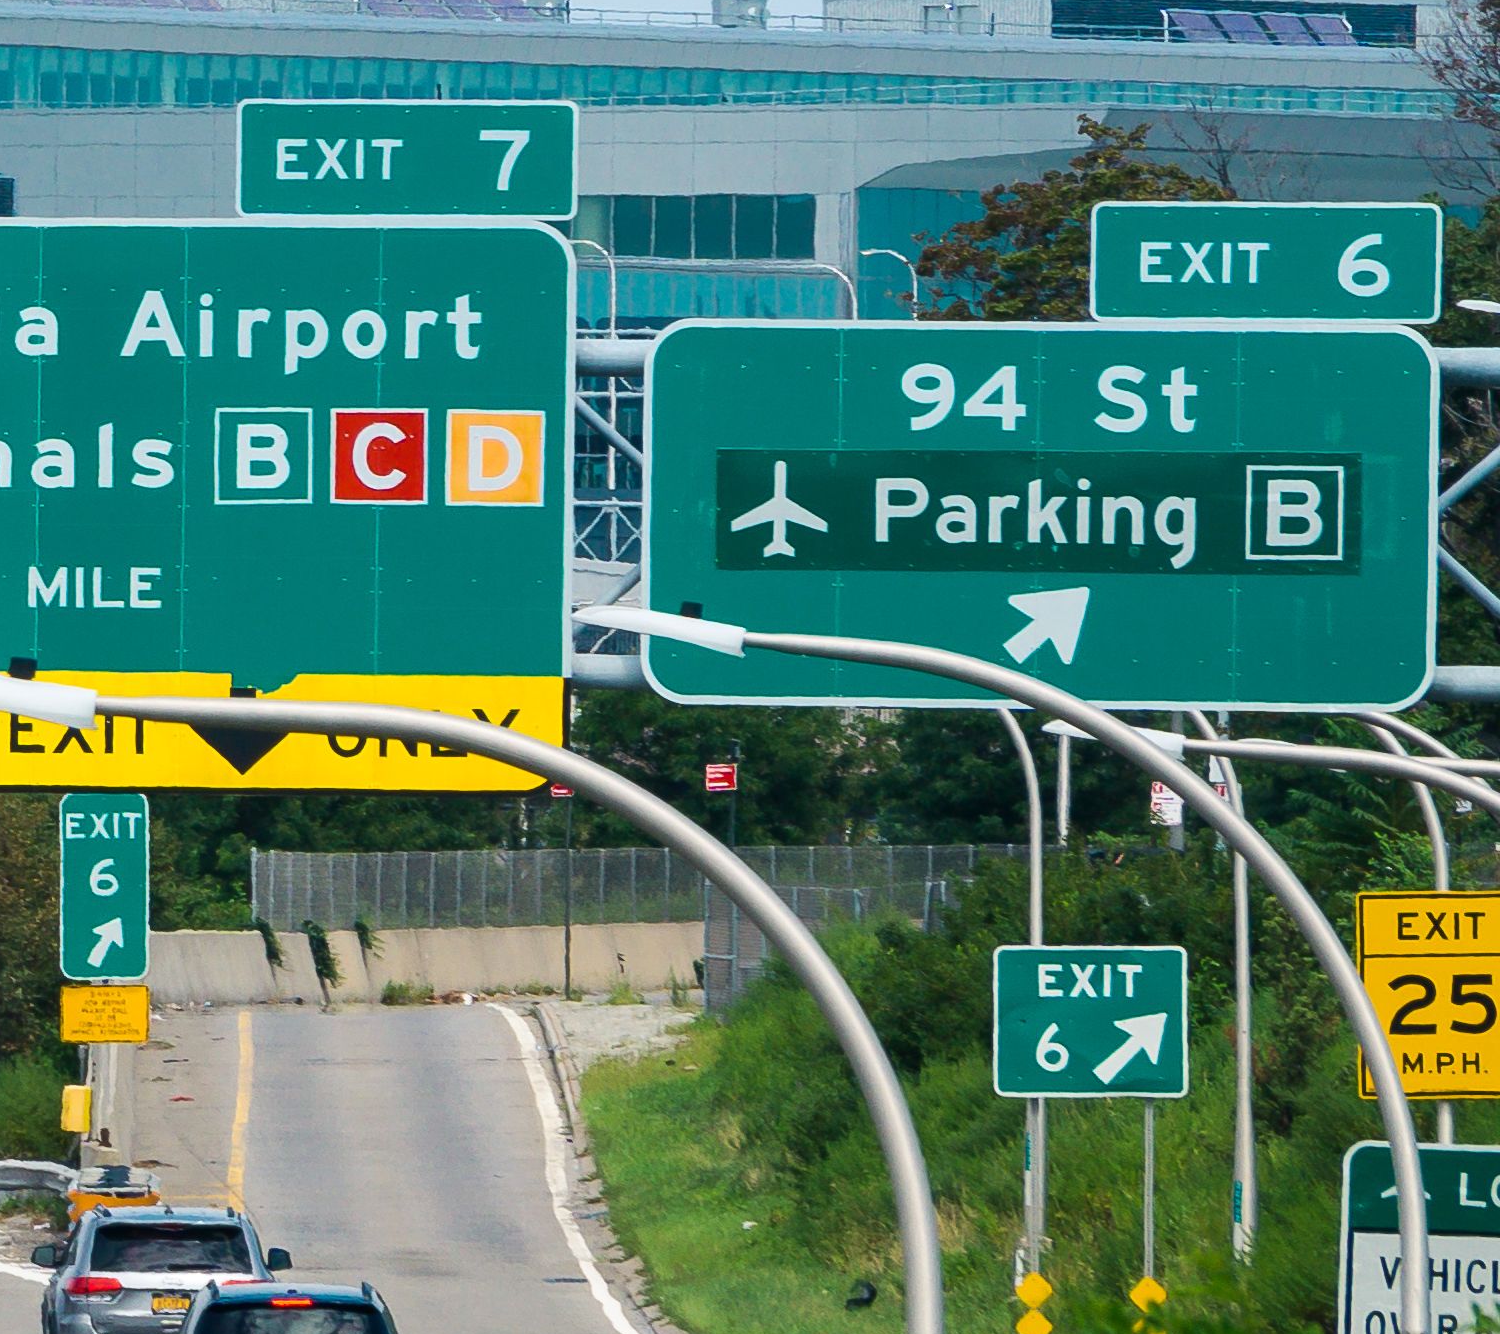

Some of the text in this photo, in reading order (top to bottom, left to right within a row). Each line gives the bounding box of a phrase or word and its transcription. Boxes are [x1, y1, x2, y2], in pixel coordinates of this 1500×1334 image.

[275, 130, 531, 192] EXIT 7
[1138, 233, 1391, 298] EXIT 6
[121, 291, 483, 373] Airport
[900, 363, 1199, 433] 94 St
[237, 424, 292, 489] B
[350, 424, 408, 490] C
[467, 425, 523, 490] D
[875, 478, 1322, 569] Parking B
[27, 566, 162, 609] MILE
[9, 710, 146, 755] EXIT
[65, 812, 141, 840] EXIT
[89, 858, 119, 896] 6
[1397, 912, 1486, 940] EXIT
[1037, 963, 1142, 998] EXIT
[1388, 973, 1498, 1035] 25
[1035, 1023, 1069, 1072] 6
[1402, 1052, 1489, 1075] M.P.H.
[1380, 1257, 1500, 1294] VHICL
